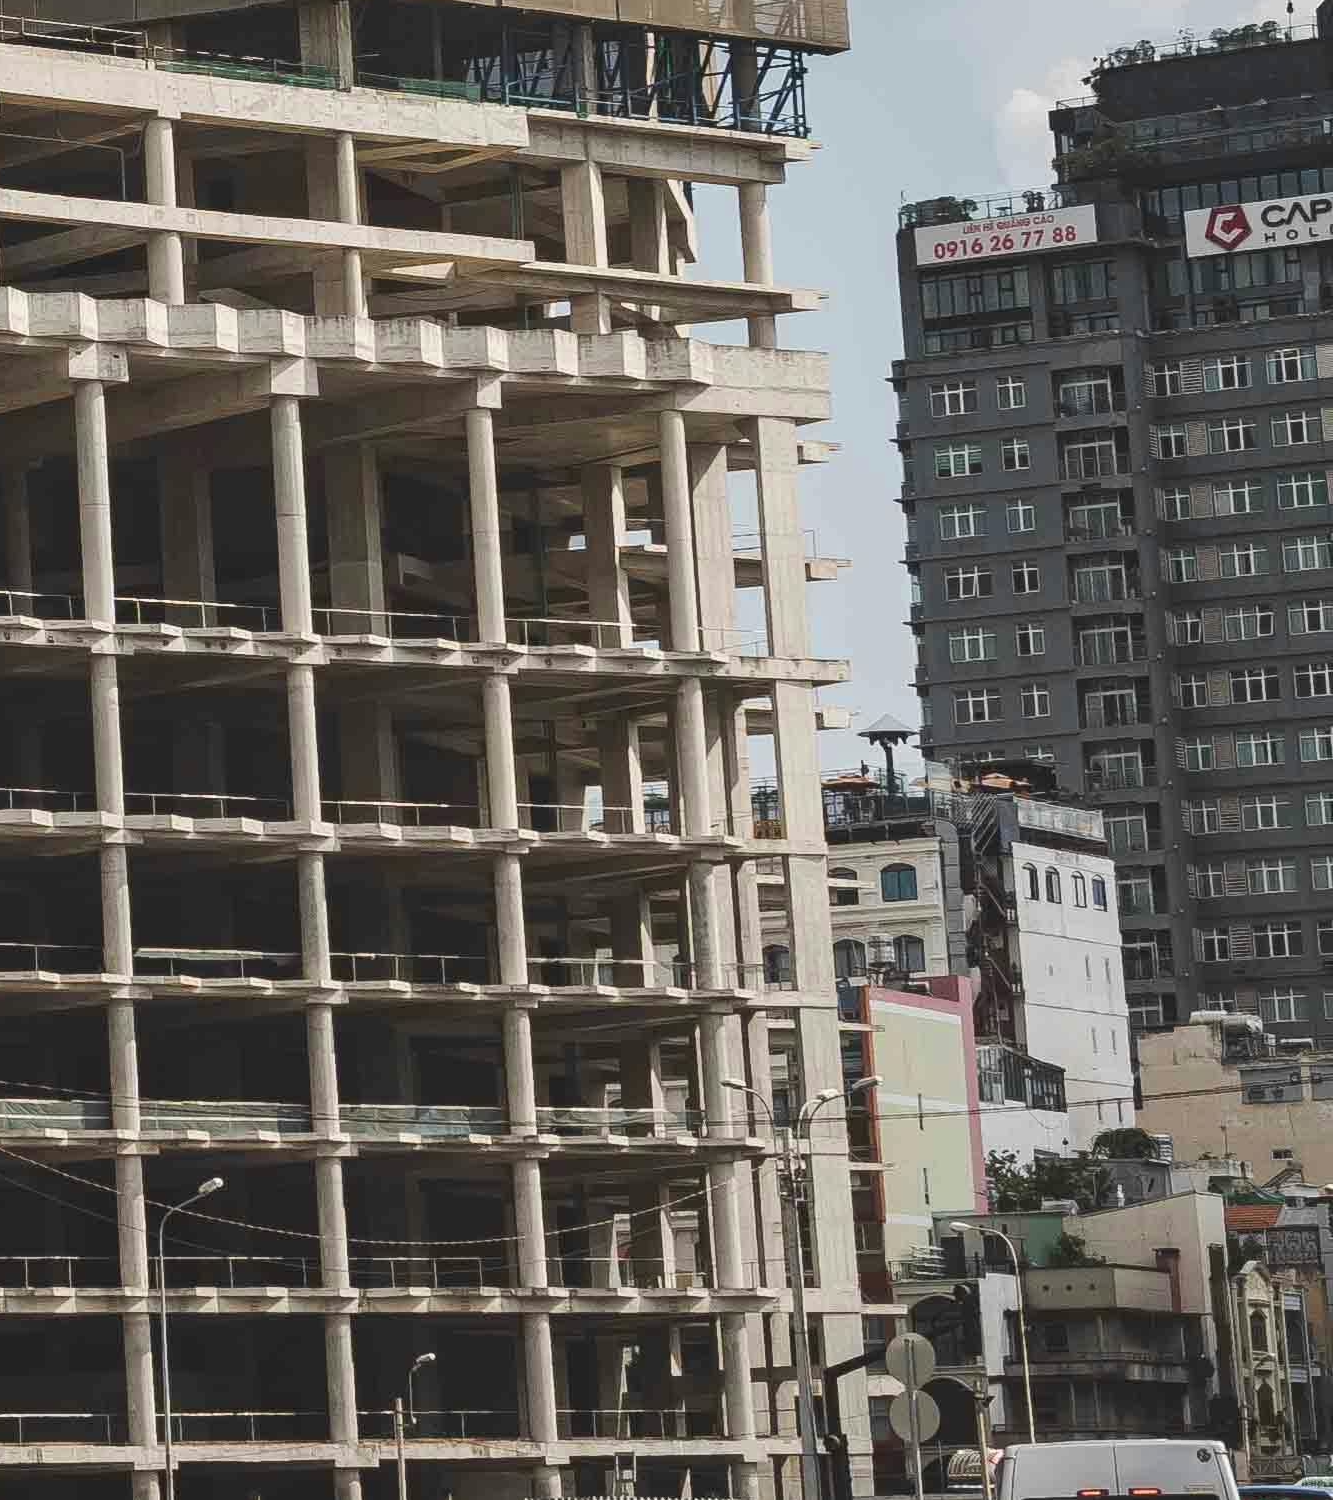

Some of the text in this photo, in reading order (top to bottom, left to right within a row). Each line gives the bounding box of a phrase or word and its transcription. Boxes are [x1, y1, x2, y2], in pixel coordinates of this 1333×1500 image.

[934, 225, 1077, 259] 0916 26 77 88
